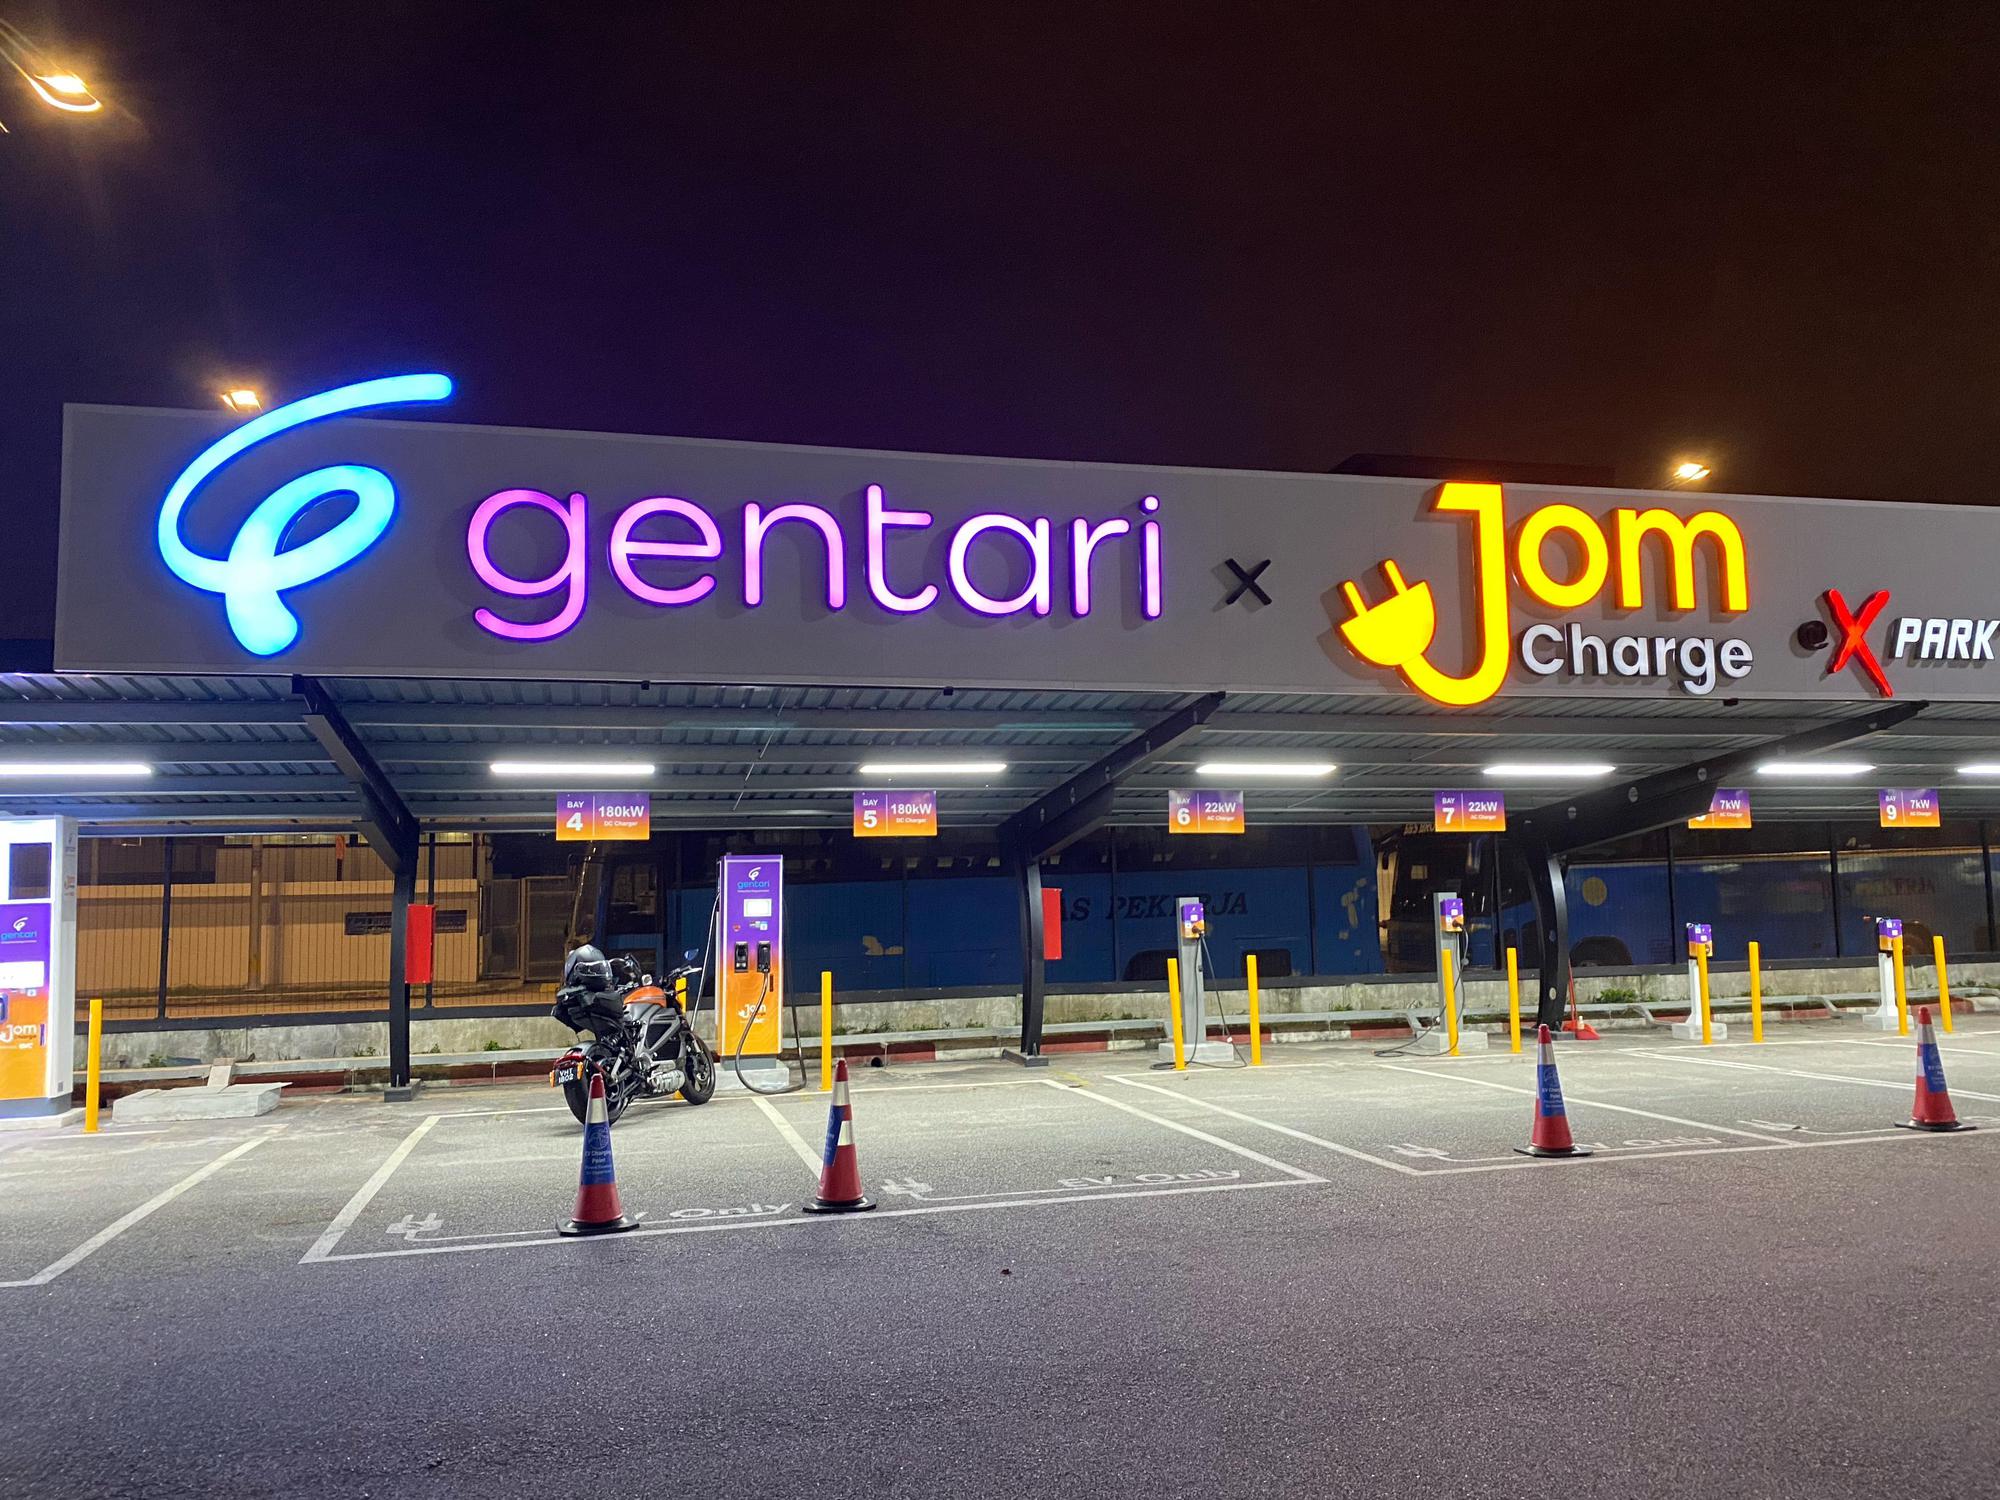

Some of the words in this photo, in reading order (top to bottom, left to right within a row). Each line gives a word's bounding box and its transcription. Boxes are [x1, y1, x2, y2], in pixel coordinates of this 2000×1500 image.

[466, 483, 1162, 641] gentari
[1340, 482, 1750, 706] Jom
[1893, 617, 2000, 661] PARK
[1520, 622, 1754, 695] Charge
[566, 801, 584, 809] BAY
[598, 805, 645, 817] 180kW
[890, 803, 932, 815] 180kW
[1204, 802, 1236, 813] 22kW
[1468, 801, 1497, 812] 22kW
[1719, 800, 1741, 810] 7kW
[1886, 804, 1897, 820] 9
[1910, 799, 1929, 809] 7kW
[565, 812, 583, 832] 4
[863, 809, 878, 828] 5
[1176, 807, 1191, 826] 6
[1442, 807, 1455, 824] 7
[736, 881, 770, 890] gentari
[1105, 892, 1249, 919] PEKRJA
[559, 1068, 573, 1077] VHT
[1058, 1176, 1113, 1188] EV
[1135, 1169, 1241, 1184] Only
[669, 1203, 793, 1218] Only
